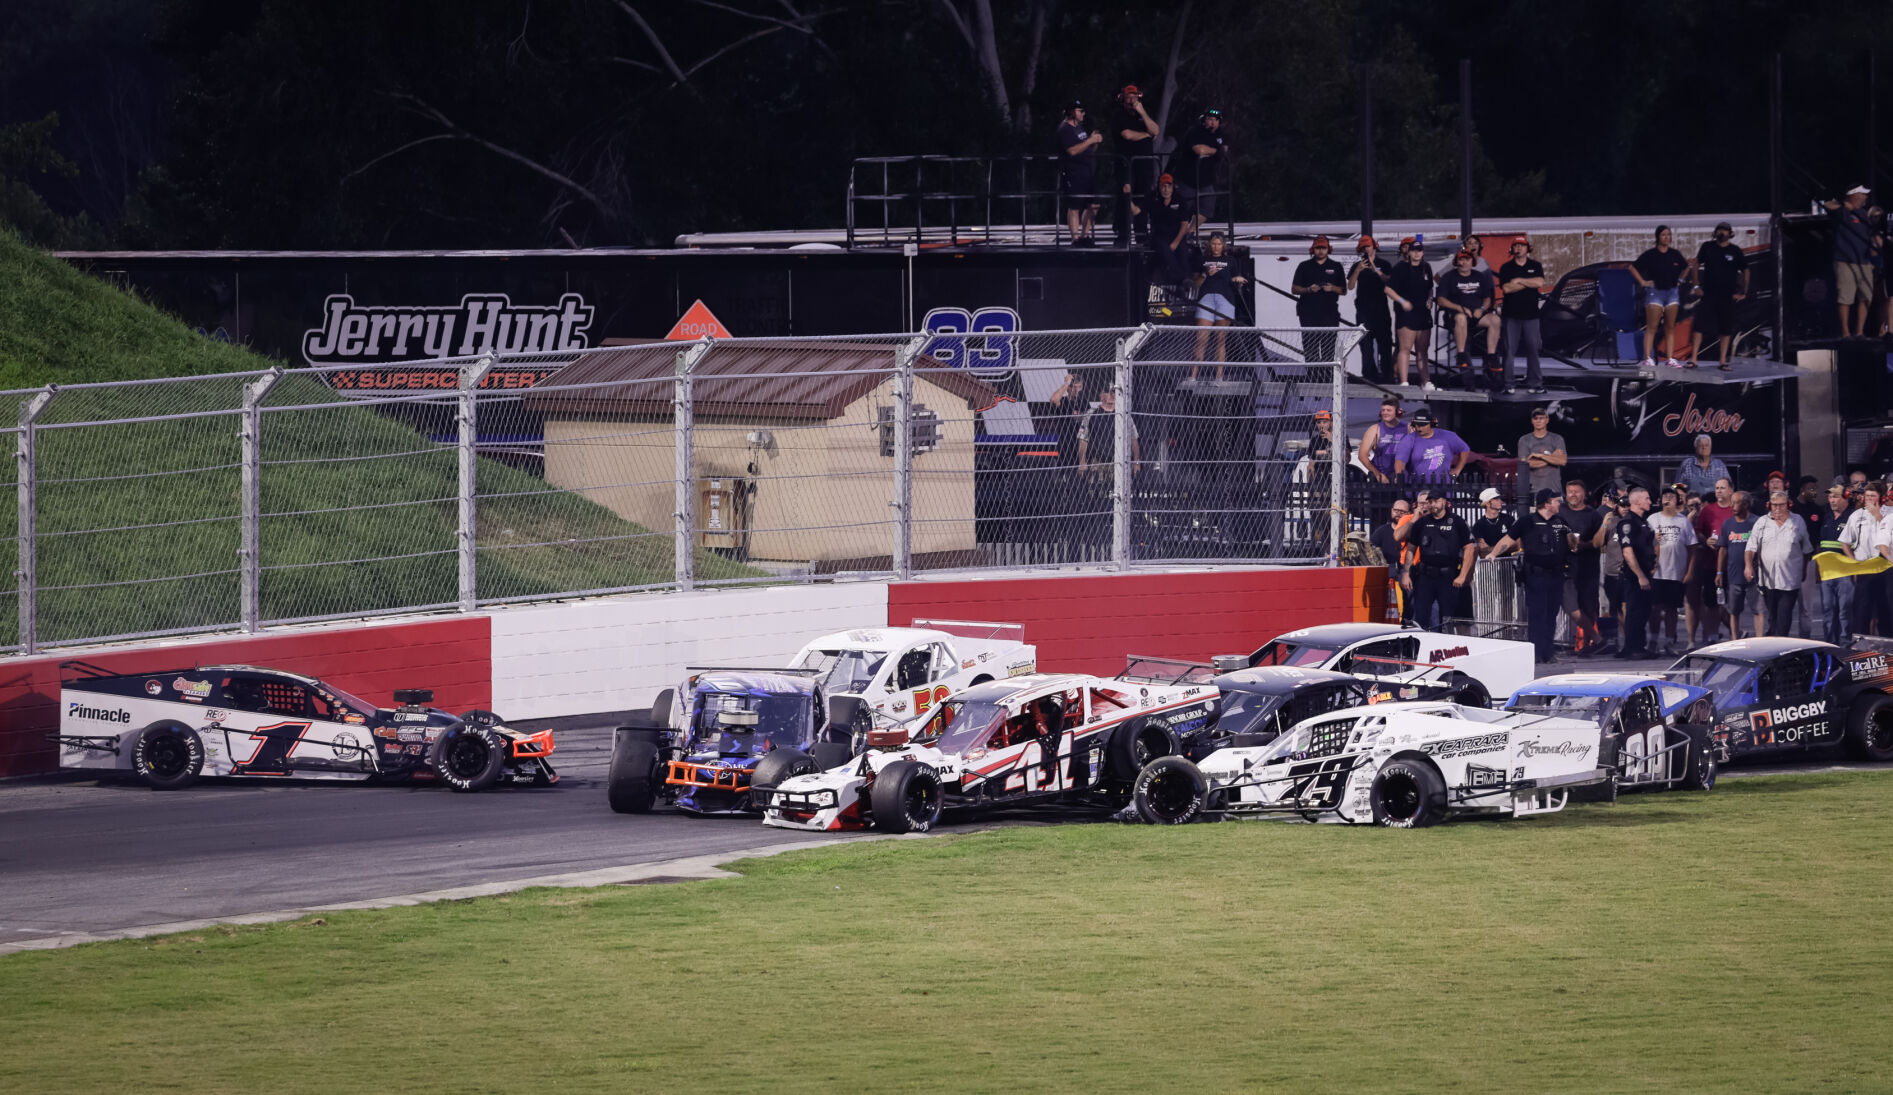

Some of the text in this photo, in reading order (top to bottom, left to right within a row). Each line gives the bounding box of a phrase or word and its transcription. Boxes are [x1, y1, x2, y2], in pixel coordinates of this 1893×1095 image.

[309, 300, 588, 359] Jerry Hunt
[680, 322, 718, 337] ROAD
[923, 307, 1020, 380] 83
[1663, 392, 1746, 437] Jason
[68, 702, 131, 724] Pinnacle
[1772, 700, 1827, 735] BIGGBY
[230, 721, 313, 776] 1
[1004, 730, 1074, 793] 41
[1441, 744, 1506, 760] car companies
[1558, 740, 1592, 762] Racing
[1277, 754, 1362, 806] 79
[1512, 766, 1525, 779] 79
